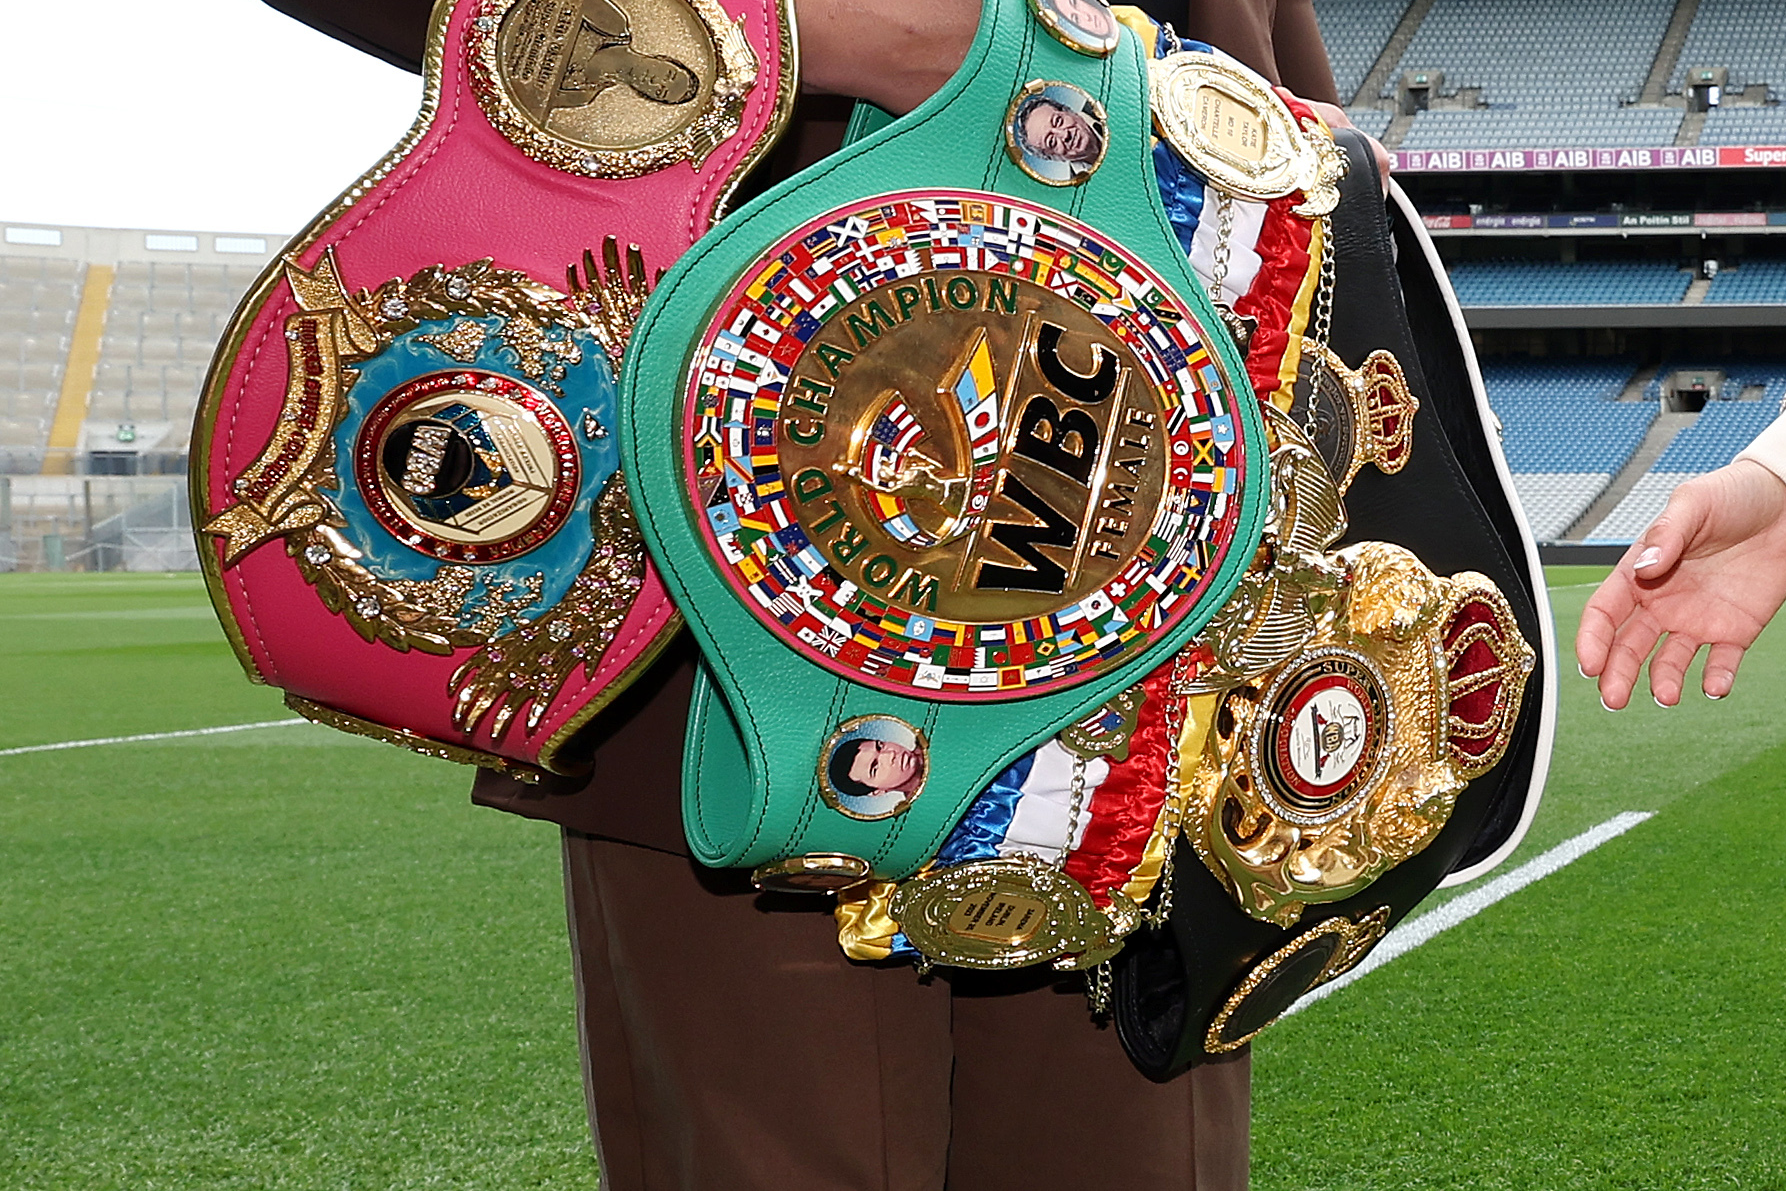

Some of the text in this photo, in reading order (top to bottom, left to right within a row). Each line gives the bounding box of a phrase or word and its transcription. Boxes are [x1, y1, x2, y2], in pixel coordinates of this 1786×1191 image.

[1211, 98, 1221, 139] CHANTELLE
[1240, 121, 1249, 147] TAYLOR
[1249, 128, 1258, 148] KATIE
[1427, 152, 1462, 169] AIB
[1491, 151, 1525, 168] AIB
[1554, 151, 1588, 167] AIB
[1618, 150, 1651, 166] AIB
[1681, 149, 1715, 166] AIB
[1622, 215, 1637, 225] An
[1672, 215, 1690, 225] Stil
[399, 422, 450, 495] WBO
[784, 276, 1018, 614] WORLD CHAMPION
[977, 321, 1121, 595] WBC
[1090, 407, 1156, 560] FEMALE
[1322, 660, 1373, 691] SUPER
[1325, 725, 1341, 753] WBA
[1346, 678, 1374, 775] WORLD BOXING
[1278, 707, 1300, 787] ASSOCIATION
[972, 892, 997, 923] NOVEMBER
[985, 902, 1006, 926] IRELAND
